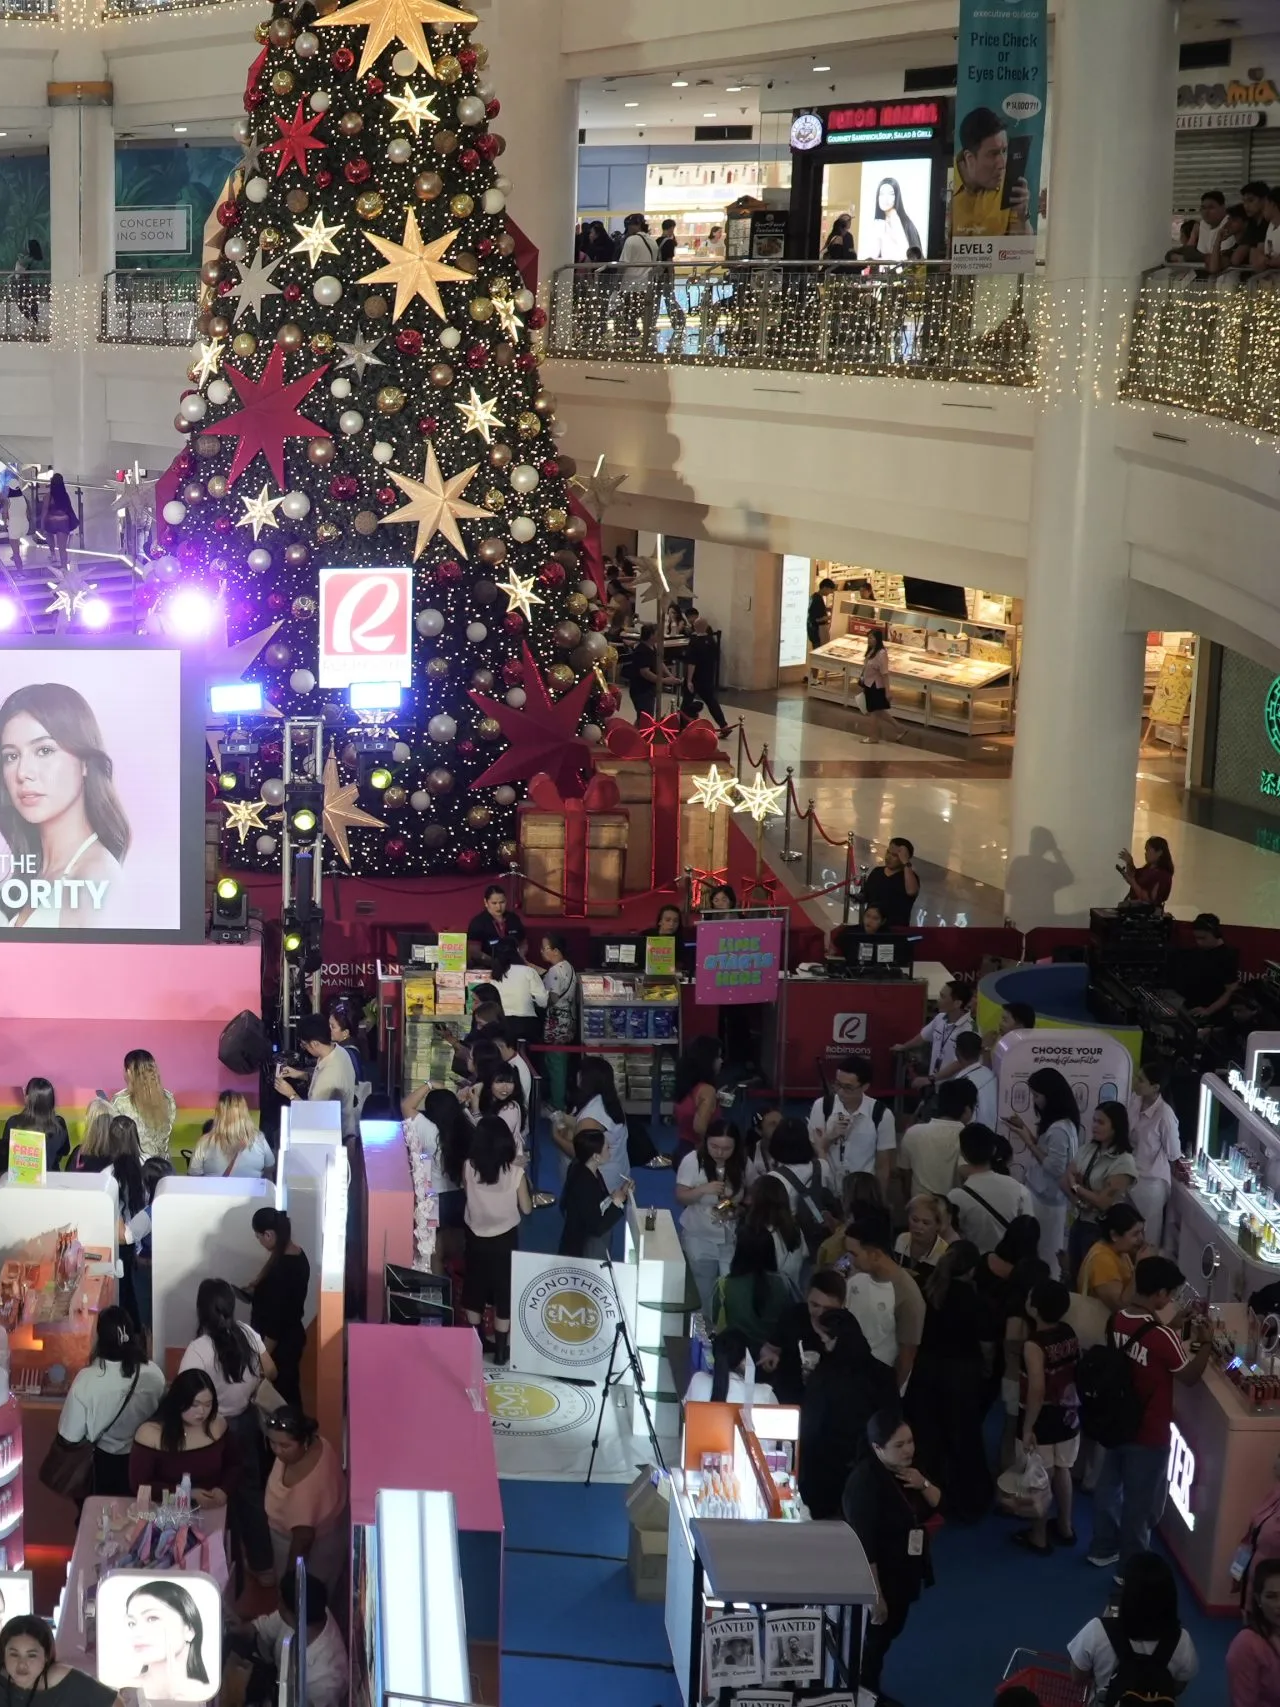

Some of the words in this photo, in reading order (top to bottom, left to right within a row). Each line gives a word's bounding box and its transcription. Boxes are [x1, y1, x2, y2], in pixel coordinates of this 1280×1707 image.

[971, 32, 1000, 46] Price
[1003, 32, 1038, 47] Check
[998, 51, 1010, 62] or
[968, 66, 994, 82] Eyes
[997, 66, 1039, 81] Check?
[1176, 116, 1203, 128] CAKES
[1217, 114, 1252, 126] GELATO
[120, 218, 174, 229] CONCEPT
[116, 231, 137, 241] ING
[140, 230, 174, 241] SOON
[953, 244, 984, 254] LEVEL
[986, 243, 993, 254] 3
[320, 978, 365, 989] MANILA
[1031, 1046, 1073, 1055] CHOOSE
[1076, 1047, 1104, 1056] YOUR
[529, 1276, 616, 1319] MONOTHEME
[710, 1621, 755, 1636] WANTED
[771, 1621, 816, 1633] WANTED
